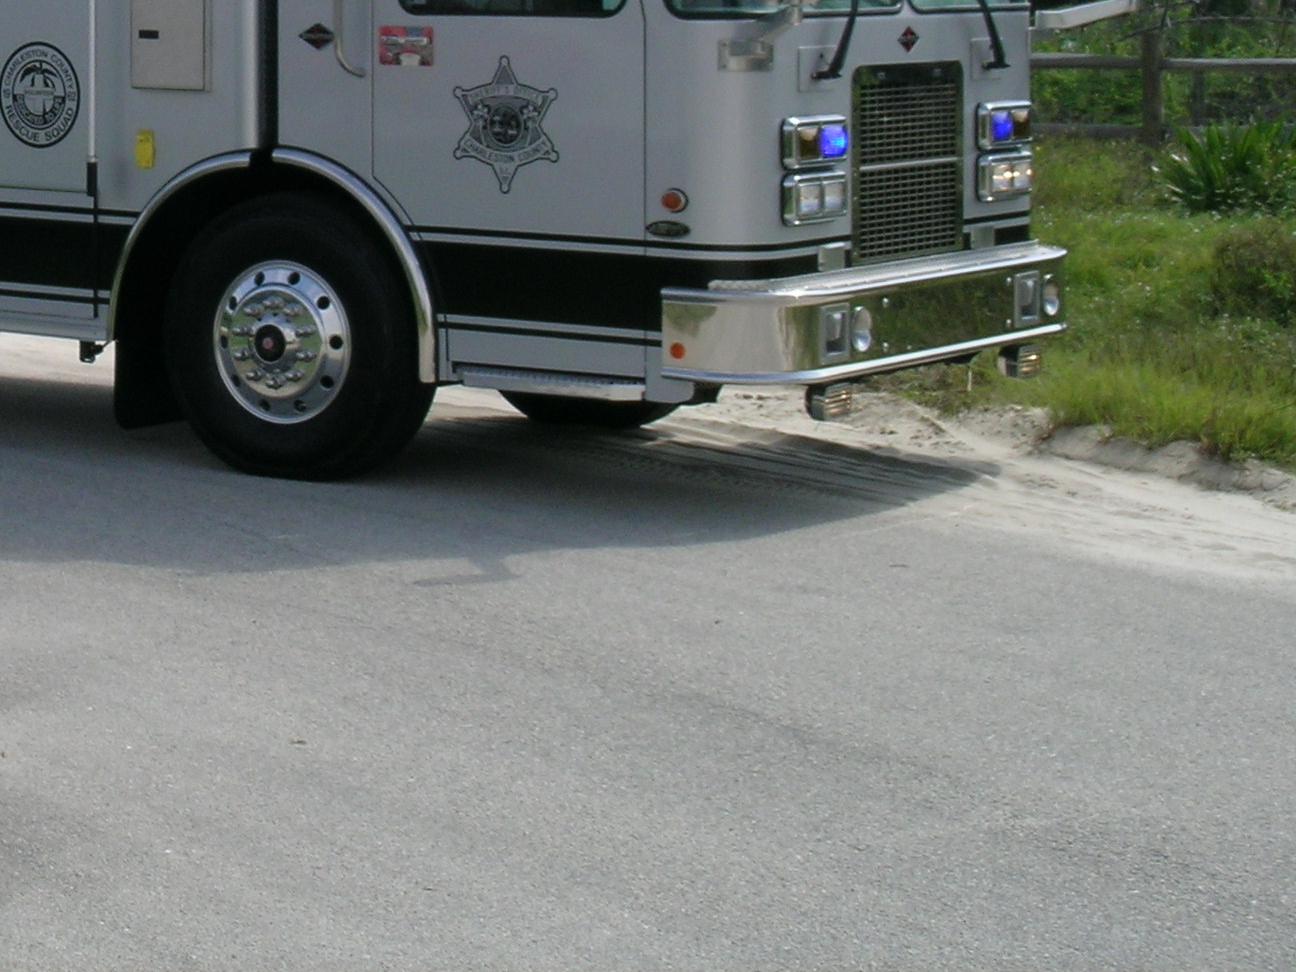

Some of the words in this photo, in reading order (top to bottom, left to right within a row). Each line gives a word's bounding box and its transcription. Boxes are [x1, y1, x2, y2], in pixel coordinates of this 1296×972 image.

[4, 49, 49, 86] CHARLESTON
[50, 54, 74, 91] COUNTY
[5, 104, 41, 142] RESCUE
[44, 107, 74, 141] SQUAD
